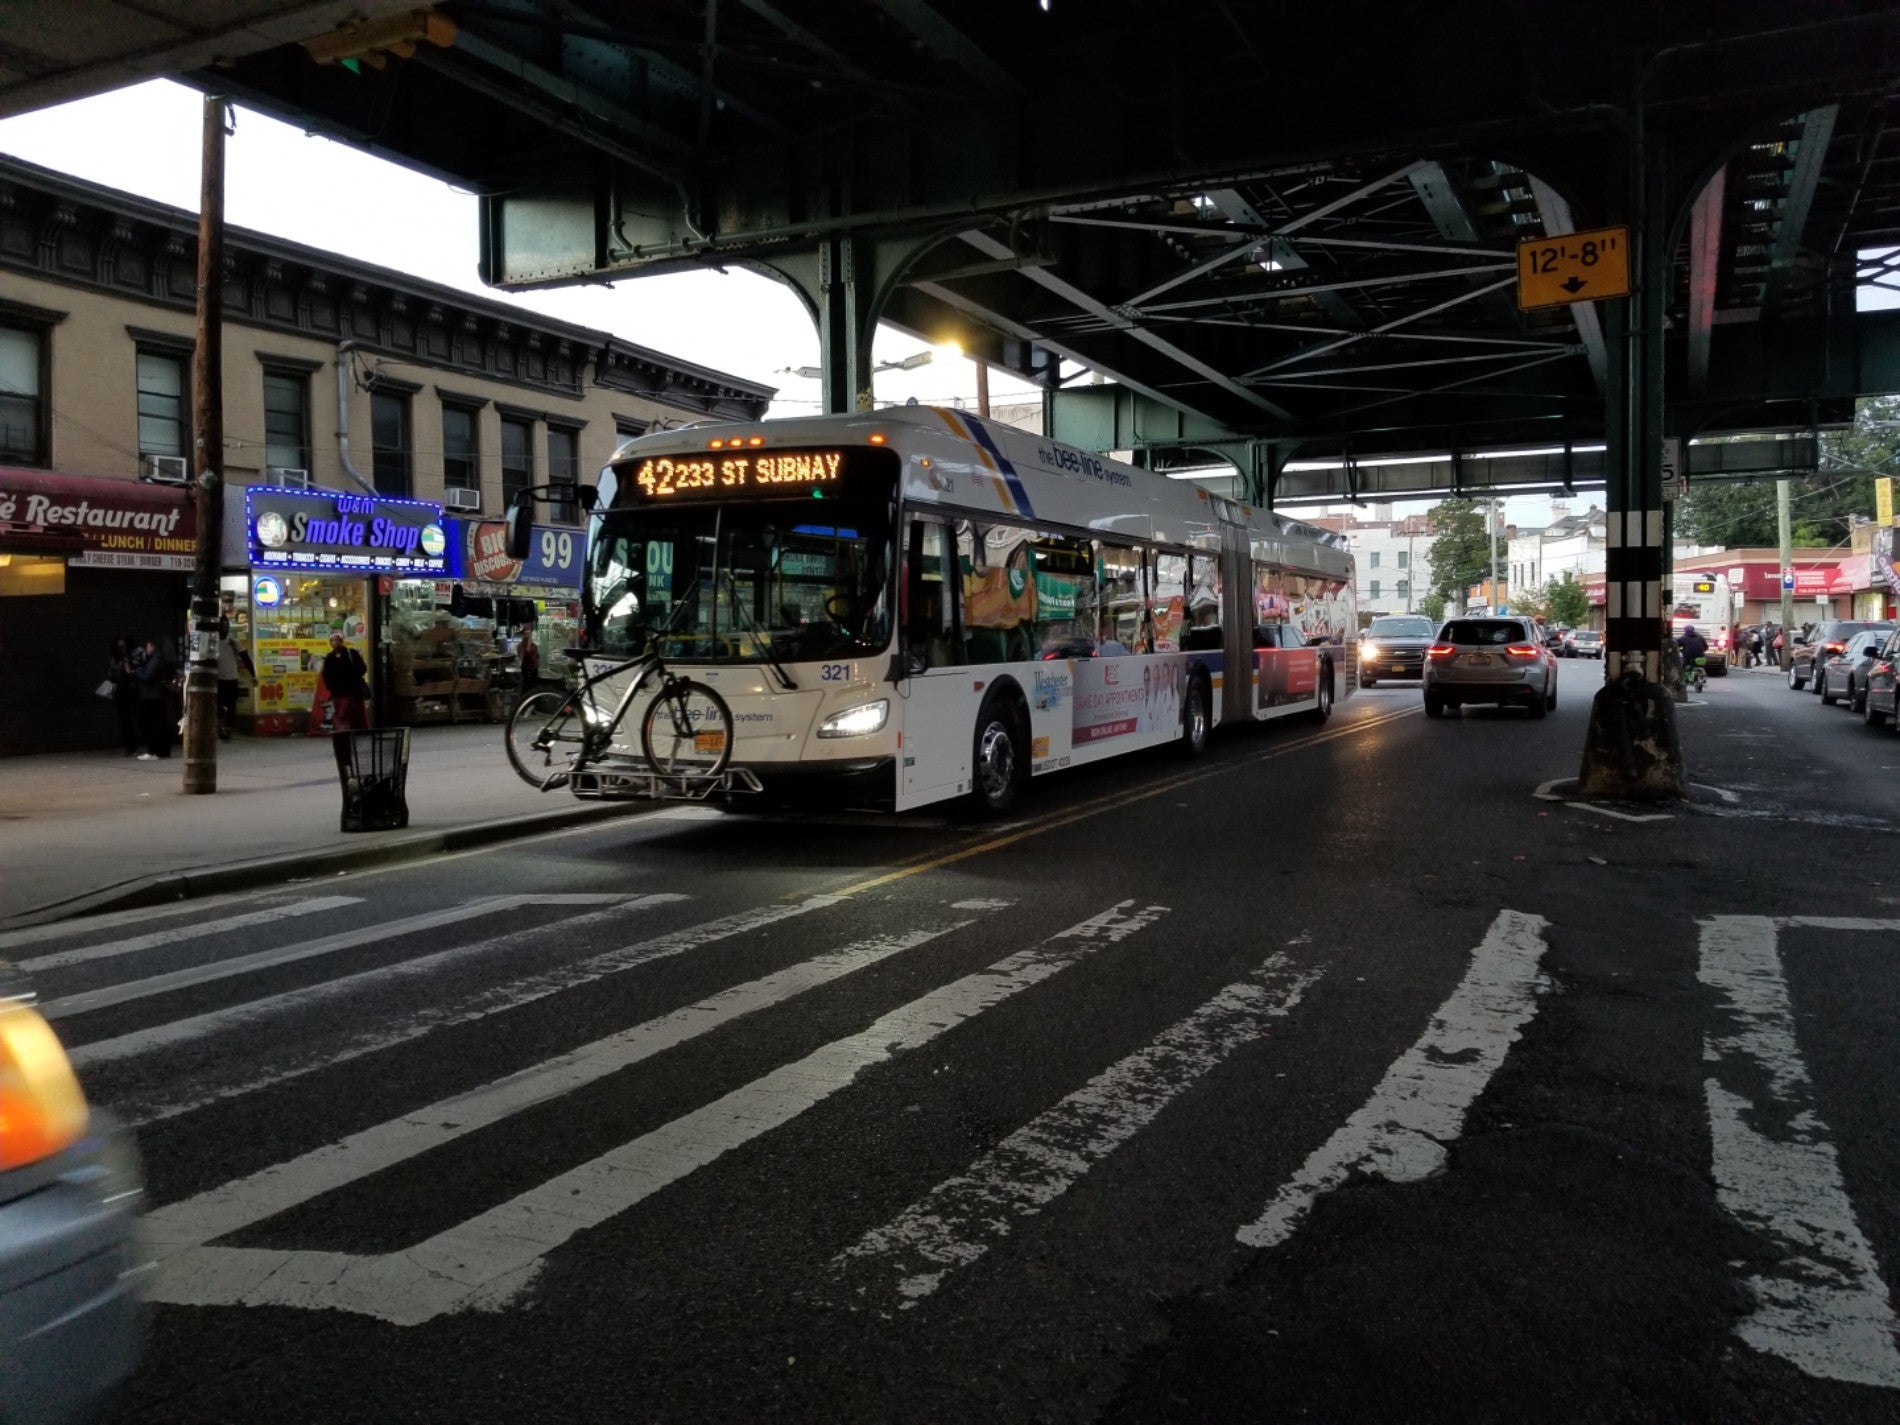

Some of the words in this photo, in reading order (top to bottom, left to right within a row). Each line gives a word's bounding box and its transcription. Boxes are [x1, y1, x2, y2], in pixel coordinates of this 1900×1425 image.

[638, 460, 675, 496] 42
[676, 463, 714, 488] 233
[722, 460, 749, 485] ST
[756, 454, 840, 483] SUBWAY
[1038, 445, 1055, 466] the
[1052, 442, 1104, 480] bee-line
[1103, 468, 1132, 487] system
[1662, 464, 1674, 480] 5
[26, 494, 180, 536] Restaurant
[291, 511, 365, 547] Smoke
[370, 516, 419, 555] Shop
[541, 531, 573, 569] 99
[821, 664, 852, 682] 321
[675, 705, 725, 721] bee-lin
[735, 712, 774, 722] system
